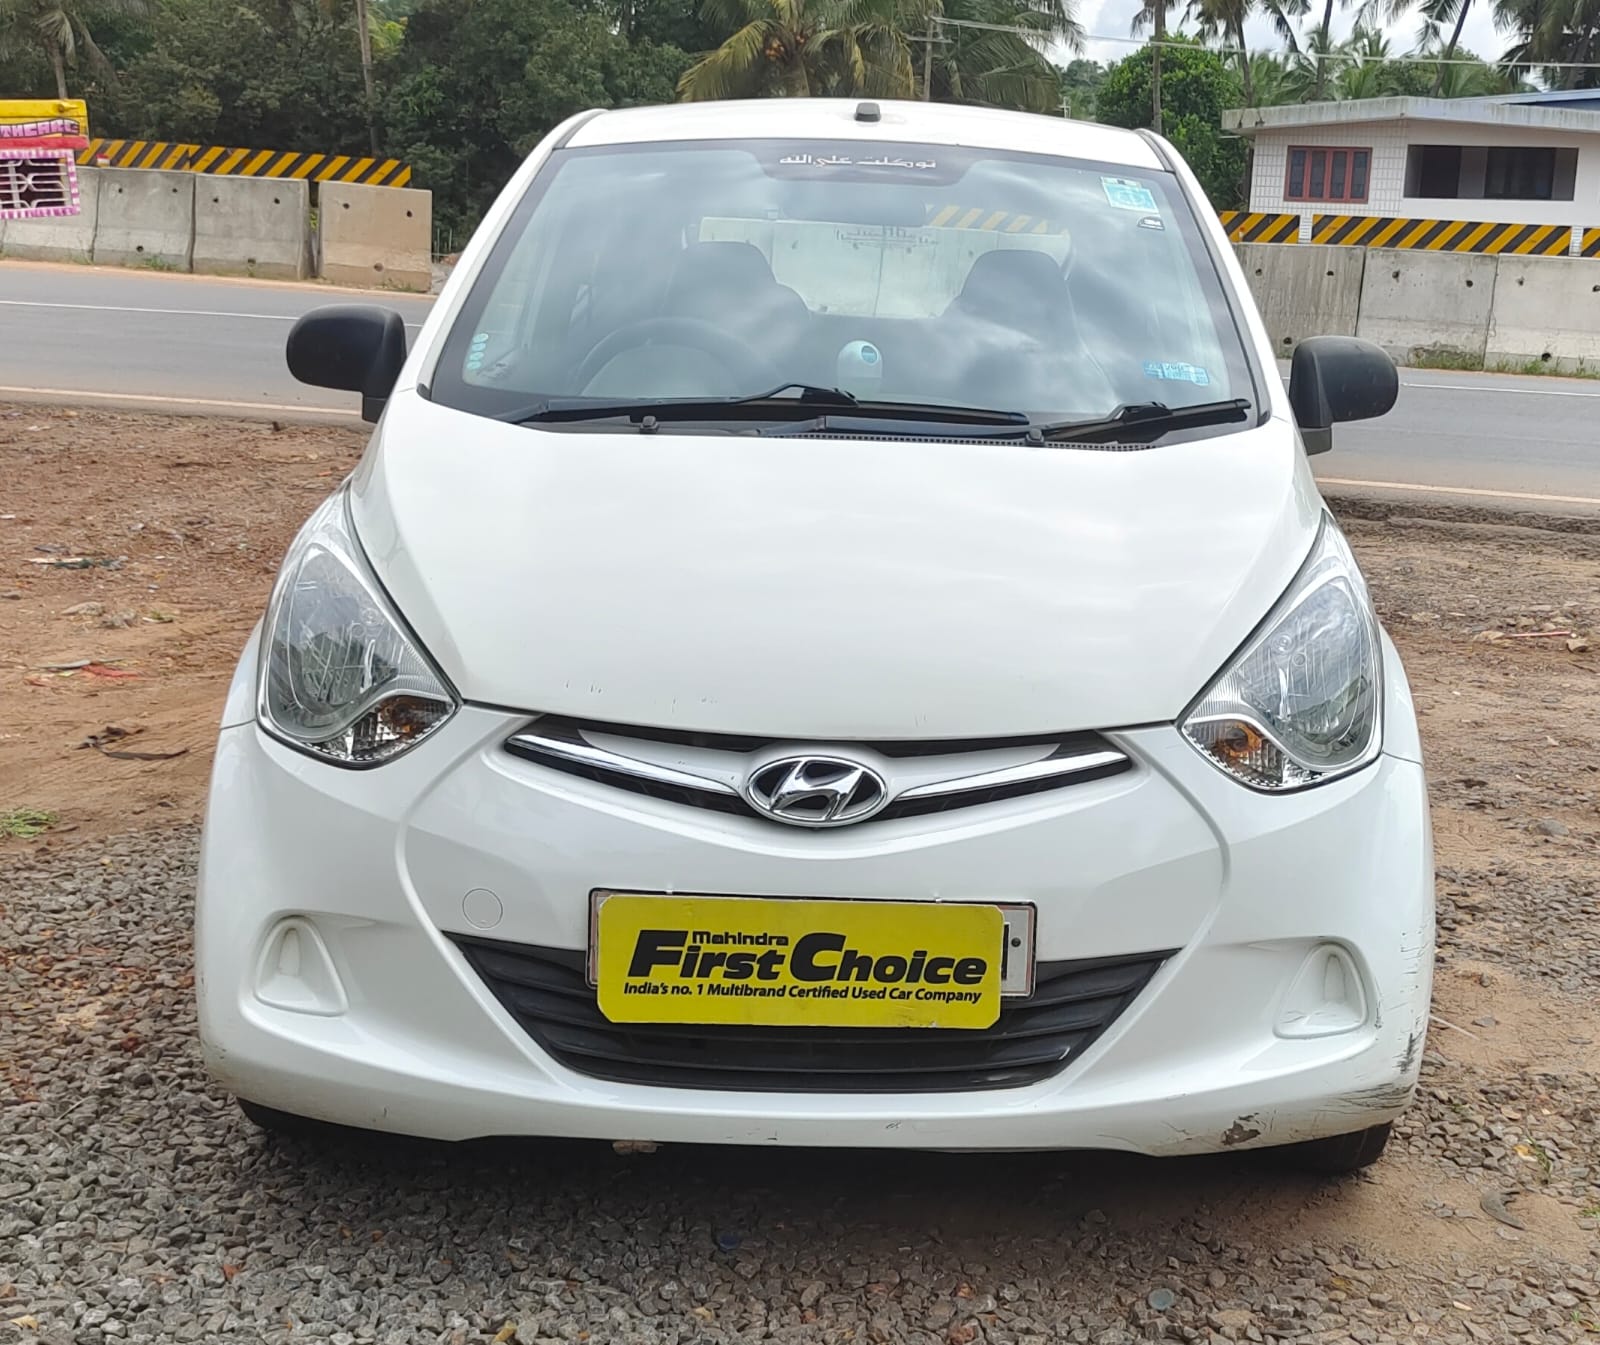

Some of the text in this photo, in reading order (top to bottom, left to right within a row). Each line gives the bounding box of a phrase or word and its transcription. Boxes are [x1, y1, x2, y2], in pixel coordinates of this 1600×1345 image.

[692, 931, 789, 946] Mahindra
[627, 929, 786, 981] First
[789, 931, 987, 985] Choice
[624, 982, 982, 1004] India's no. 1 Multibrand Certified Used Car Company
